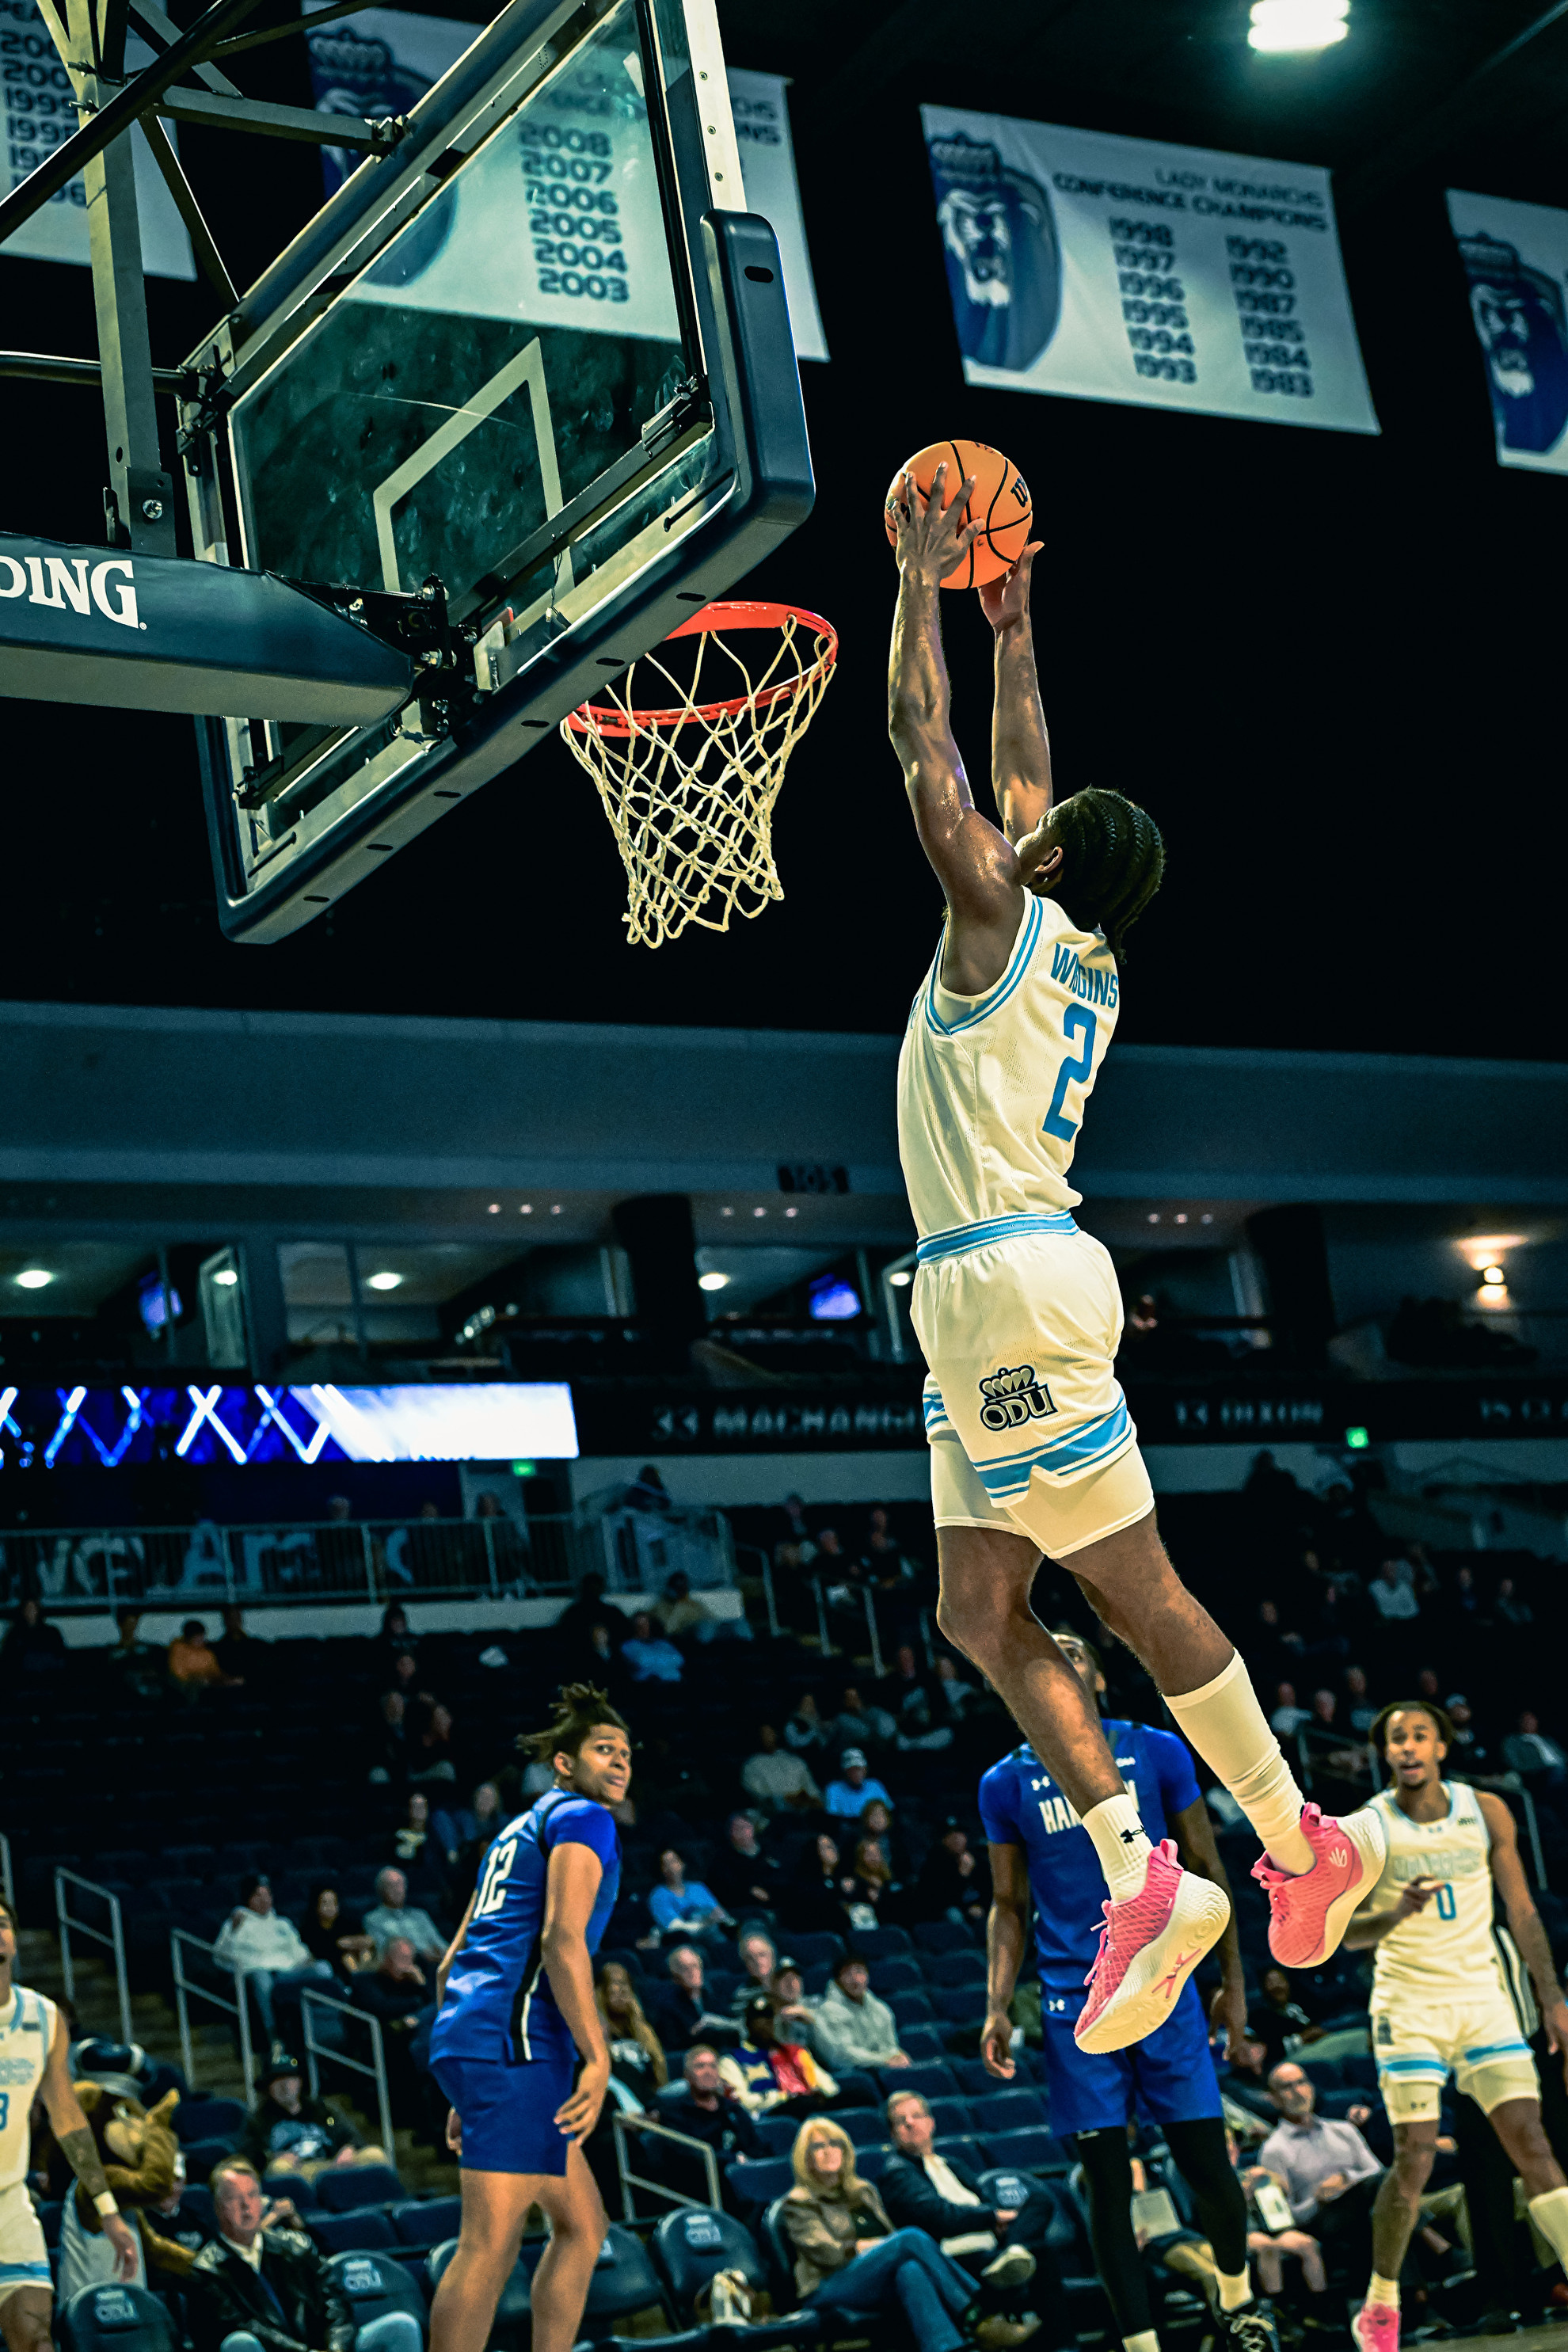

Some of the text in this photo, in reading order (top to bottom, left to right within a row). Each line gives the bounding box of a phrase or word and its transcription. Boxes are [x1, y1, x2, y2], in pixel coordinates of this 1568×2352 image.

[519, 120, 611, 158] 2008
[521, 150, 613, 185] 2007
[526, 179, 618, 215] 2006
[1052, 171, 1328, 233] CONFERENCE CHAMPIONS
[530, 208, 622, 244] 2005
[534, 238, 628, 274] 2004
[1113, 244, 1175, 273] 1997
[538, 267, 630, 303] 2003
[1118, 272, 1186, 303] 1996
[1126, 327, 1195, 356] 1994
[0, 555, 139, 629] DING
[1042, 1002, 1098, 1143] 2
[981, 1385, 1057, 1431] ODU
[473, 1838, 518, 1920] 12
[1436, 1884, 1457, 1921] 0
